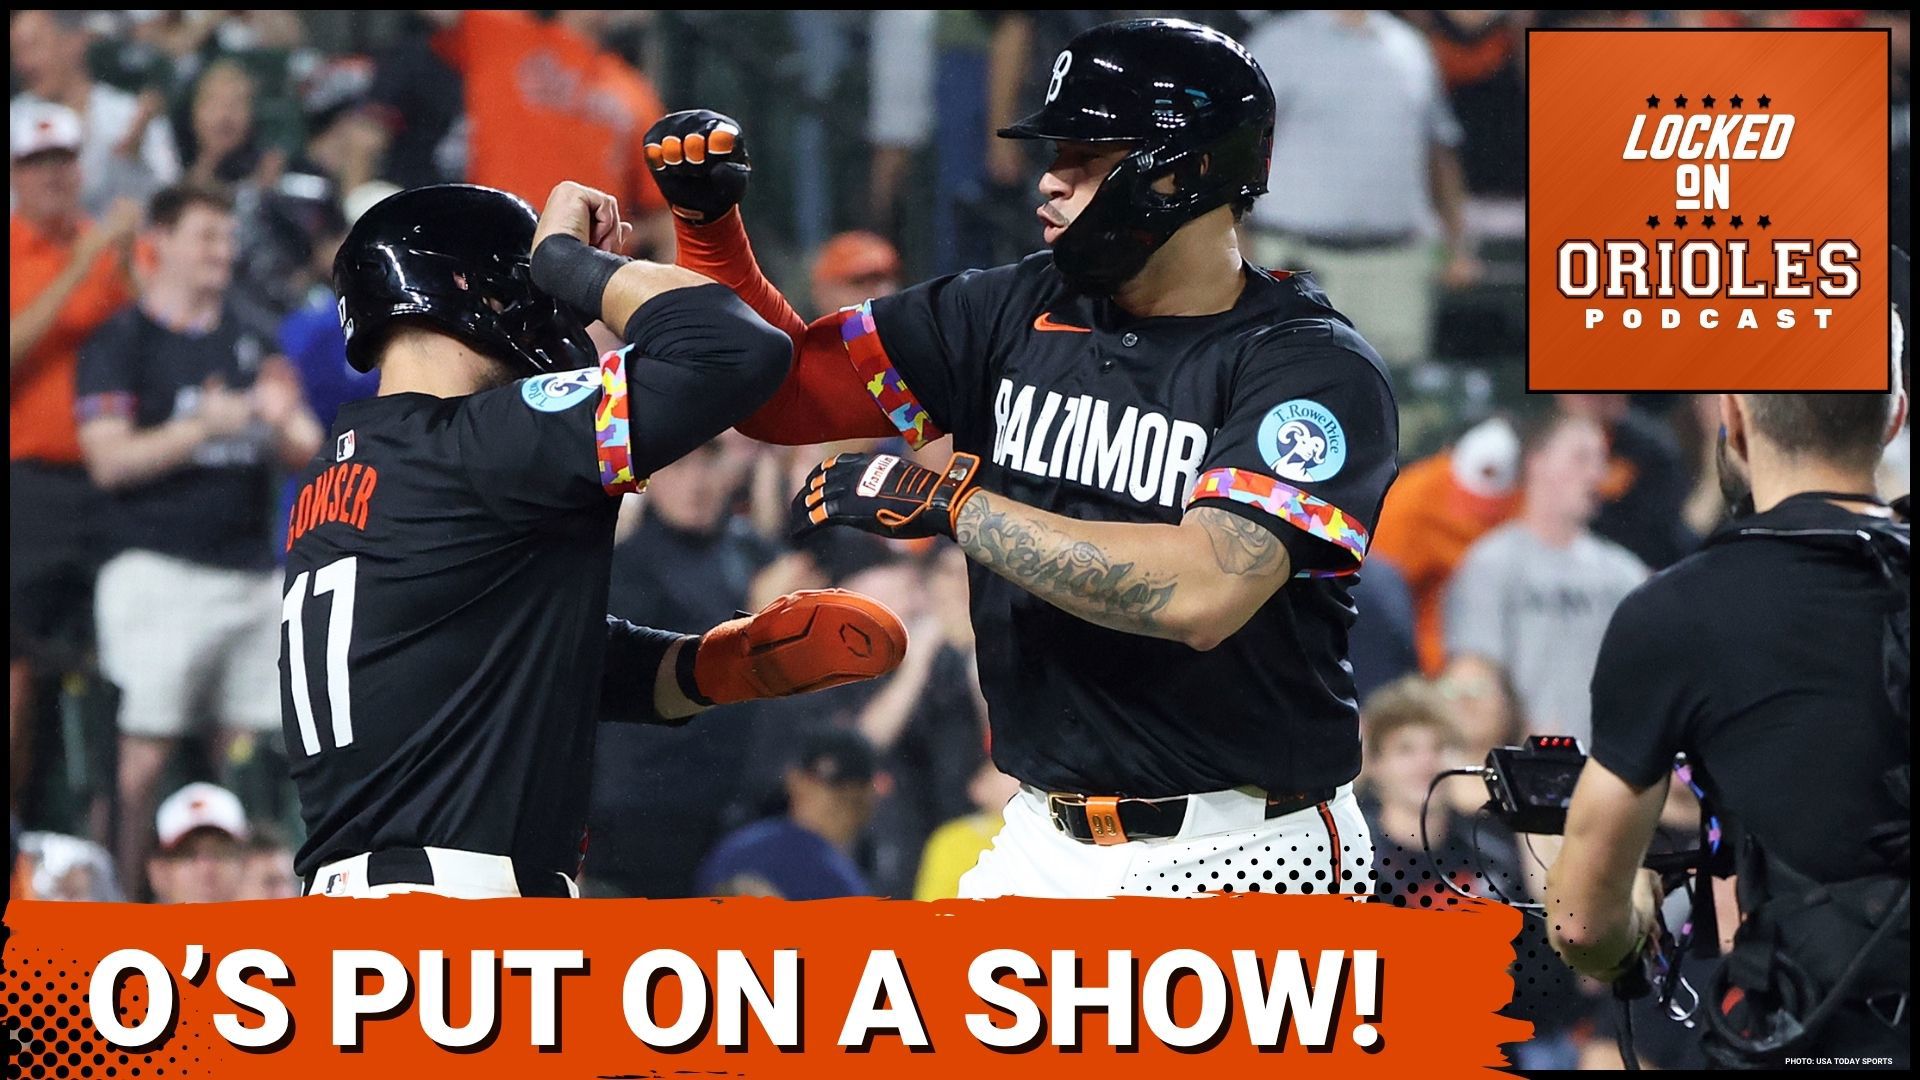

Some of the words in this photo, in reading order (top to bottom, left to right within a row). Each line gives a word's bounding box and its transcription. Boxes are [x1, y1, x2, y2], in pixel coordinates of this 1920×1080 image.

[862, 456, 895, 492] Franklin
[992, 378, 1218, 509] BALTIMOR
[281, 555, 358, 757] 17
